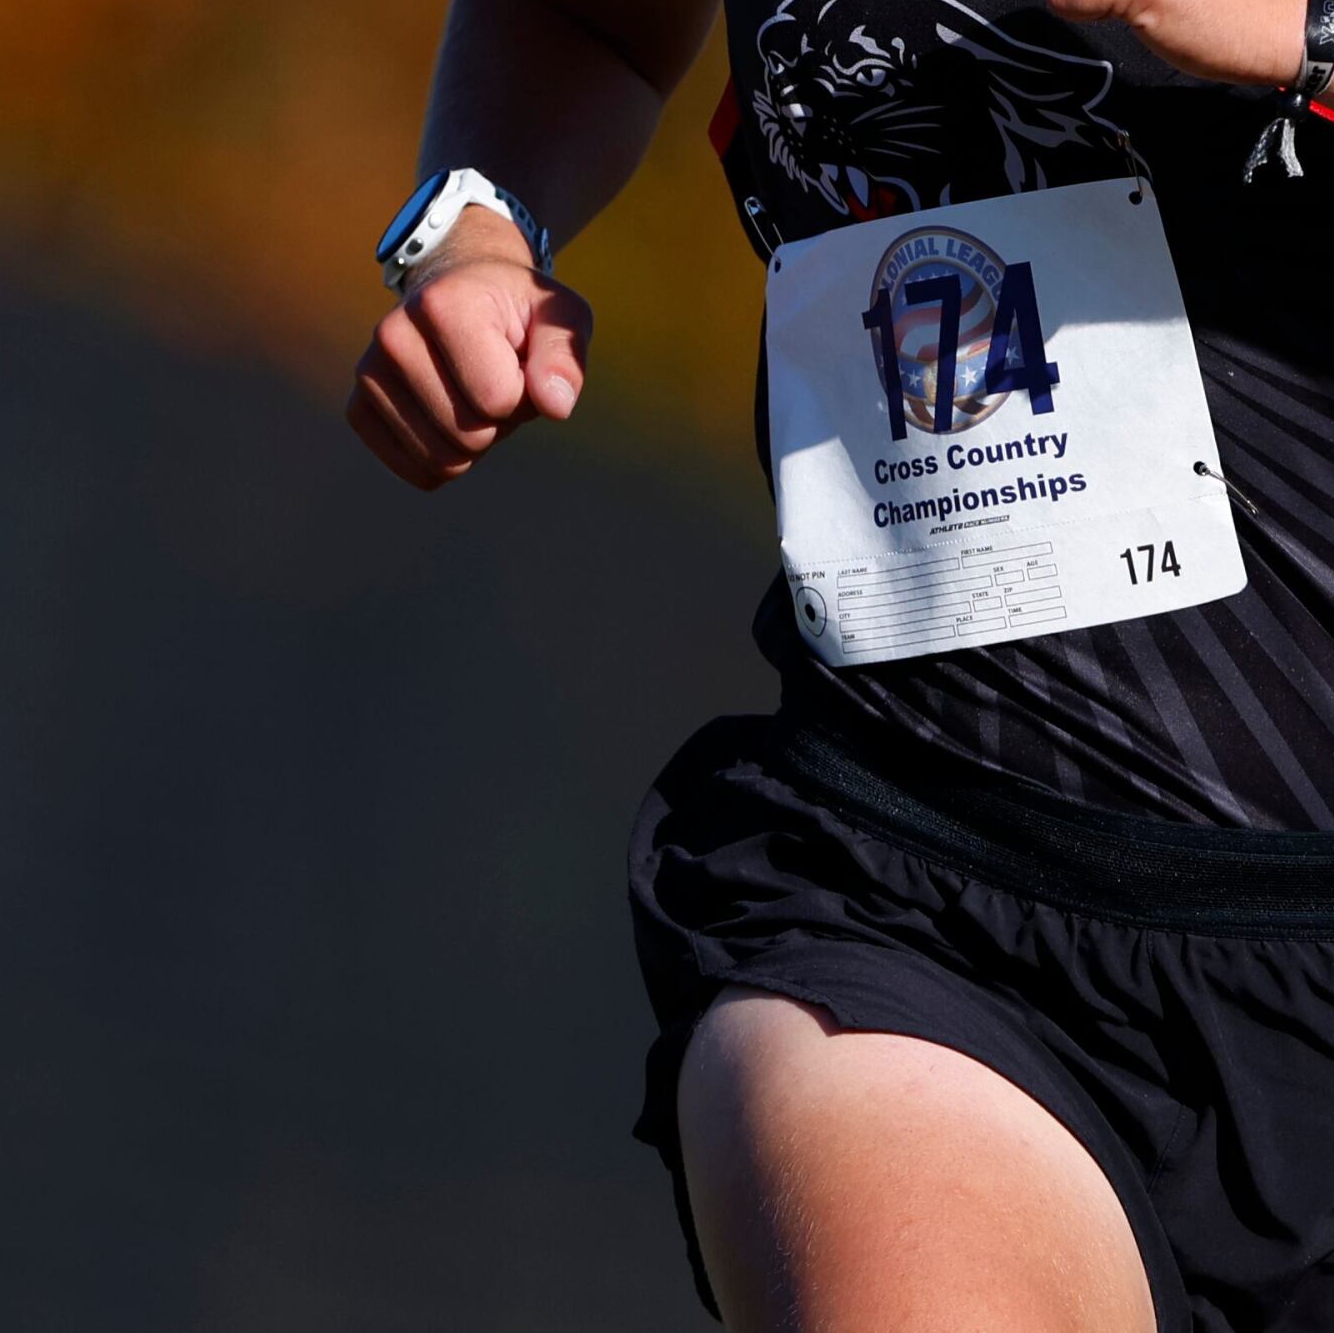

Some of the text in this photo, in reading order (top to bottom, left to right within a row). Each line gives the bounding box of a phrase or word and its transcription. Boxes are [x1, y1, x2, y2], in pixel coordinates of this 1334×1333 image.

[880, 237, 940, 292] LONIAL
[861, 261, 1061, 442] 174
[874, 432, 1069, 485] Cross Country
[873, 472, 1088, 528] Championships
[960, 545, 993, 556] FIRST NAME
[1026, 559, 1038, 567] AGE
[1120, 540, 1182, 586] 174
[811, 570, 826, 580] PIN
[837, 567, 868, 576] LAST NAME
[972, 590, 989, 599] STATE
[1003, 586, 1013, 594] ZIP
[1008, 606, 1022, 614] TIME
[839, 612, 851, 620] CITY
[956, 614, 973, 623] PLACE
